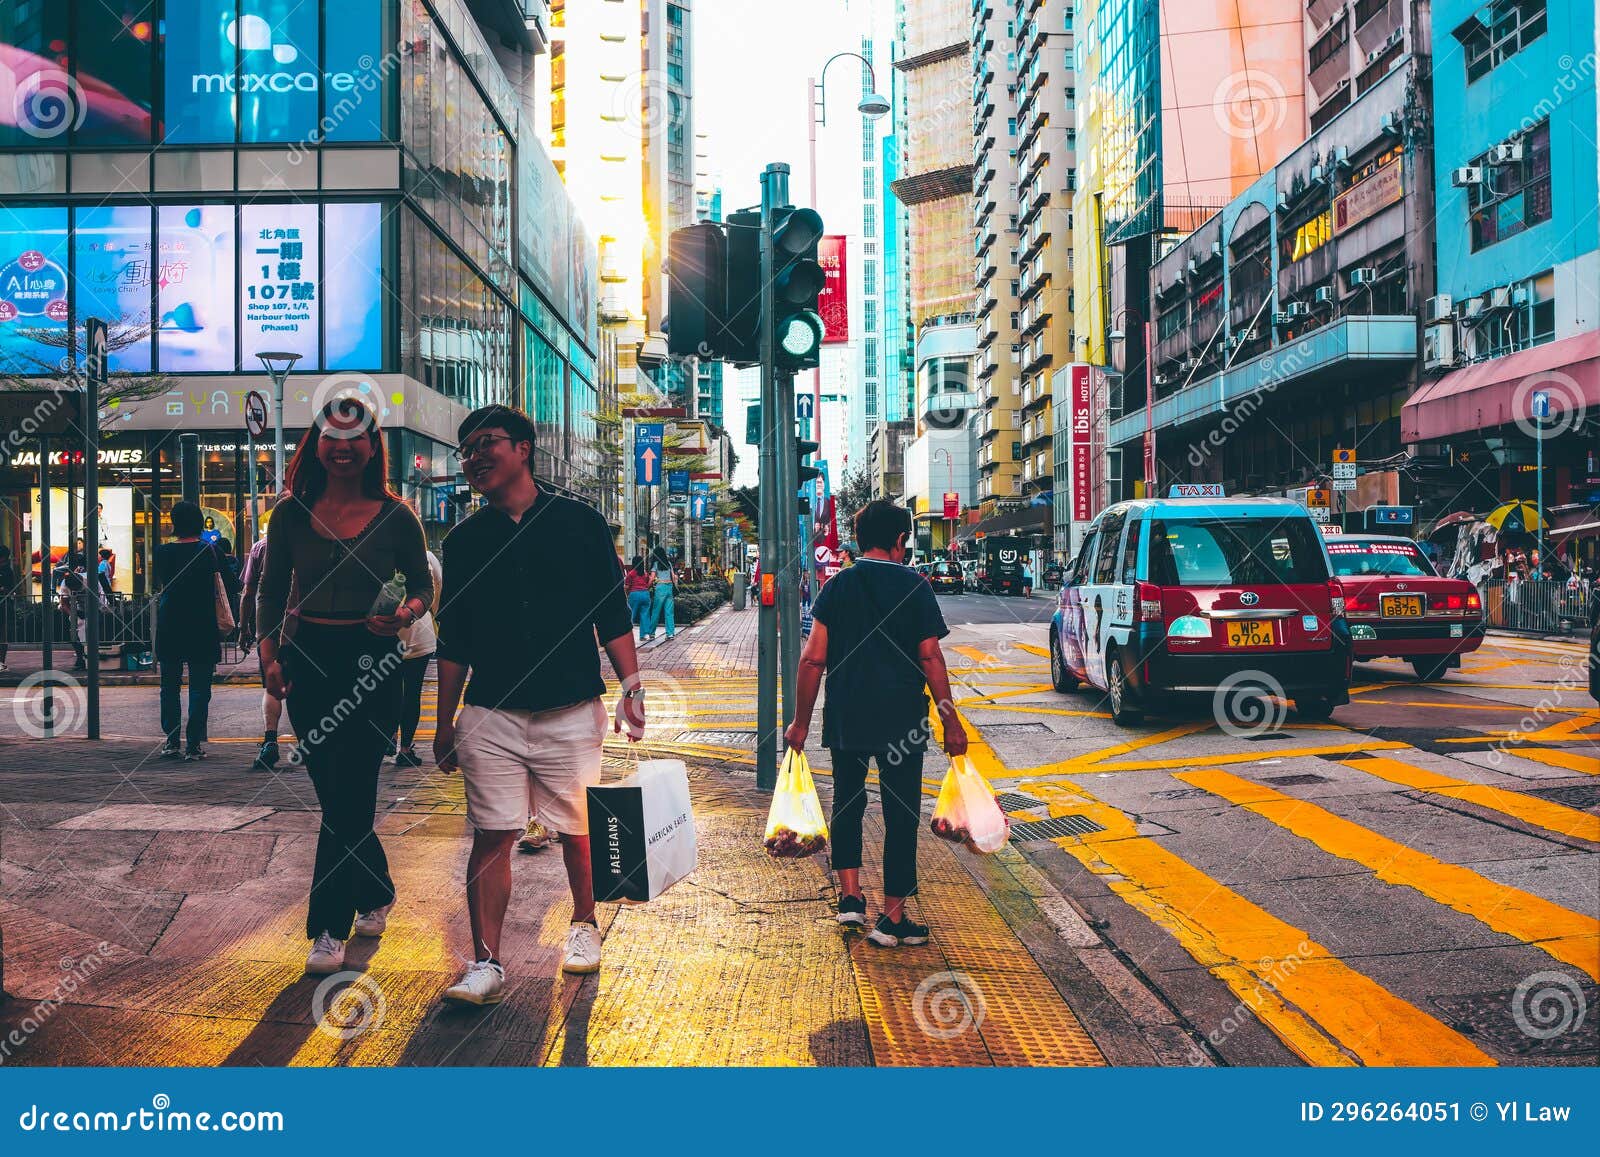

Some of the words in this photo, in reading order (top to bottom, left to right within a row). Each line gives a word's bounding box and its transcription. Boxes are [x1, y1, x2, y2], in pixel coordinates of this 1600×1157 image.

[192, 71, 356, 93] maxcare
[256, 242, 302, 260] 一期
[248, 303, 270, 311] Shop
[247, 313, 283, 321] Harbour
[1081, 375, 1089, 402] HOTEL
[1074, 407, 1089, 434] ibis
[640, 428, 647, 436] P
[1178, 485, 1220, 495] TAXI
[1394, 597, 1409, 607] SJ
[1387, 606, 1418, 616] 8876
[1240, 622, 1260, 634] WP
[1231, 633, 1271, 646] 9704
[648, 823, 674, 845] AMERICAN
[608, 816, 622, 874] #AEJEANS
